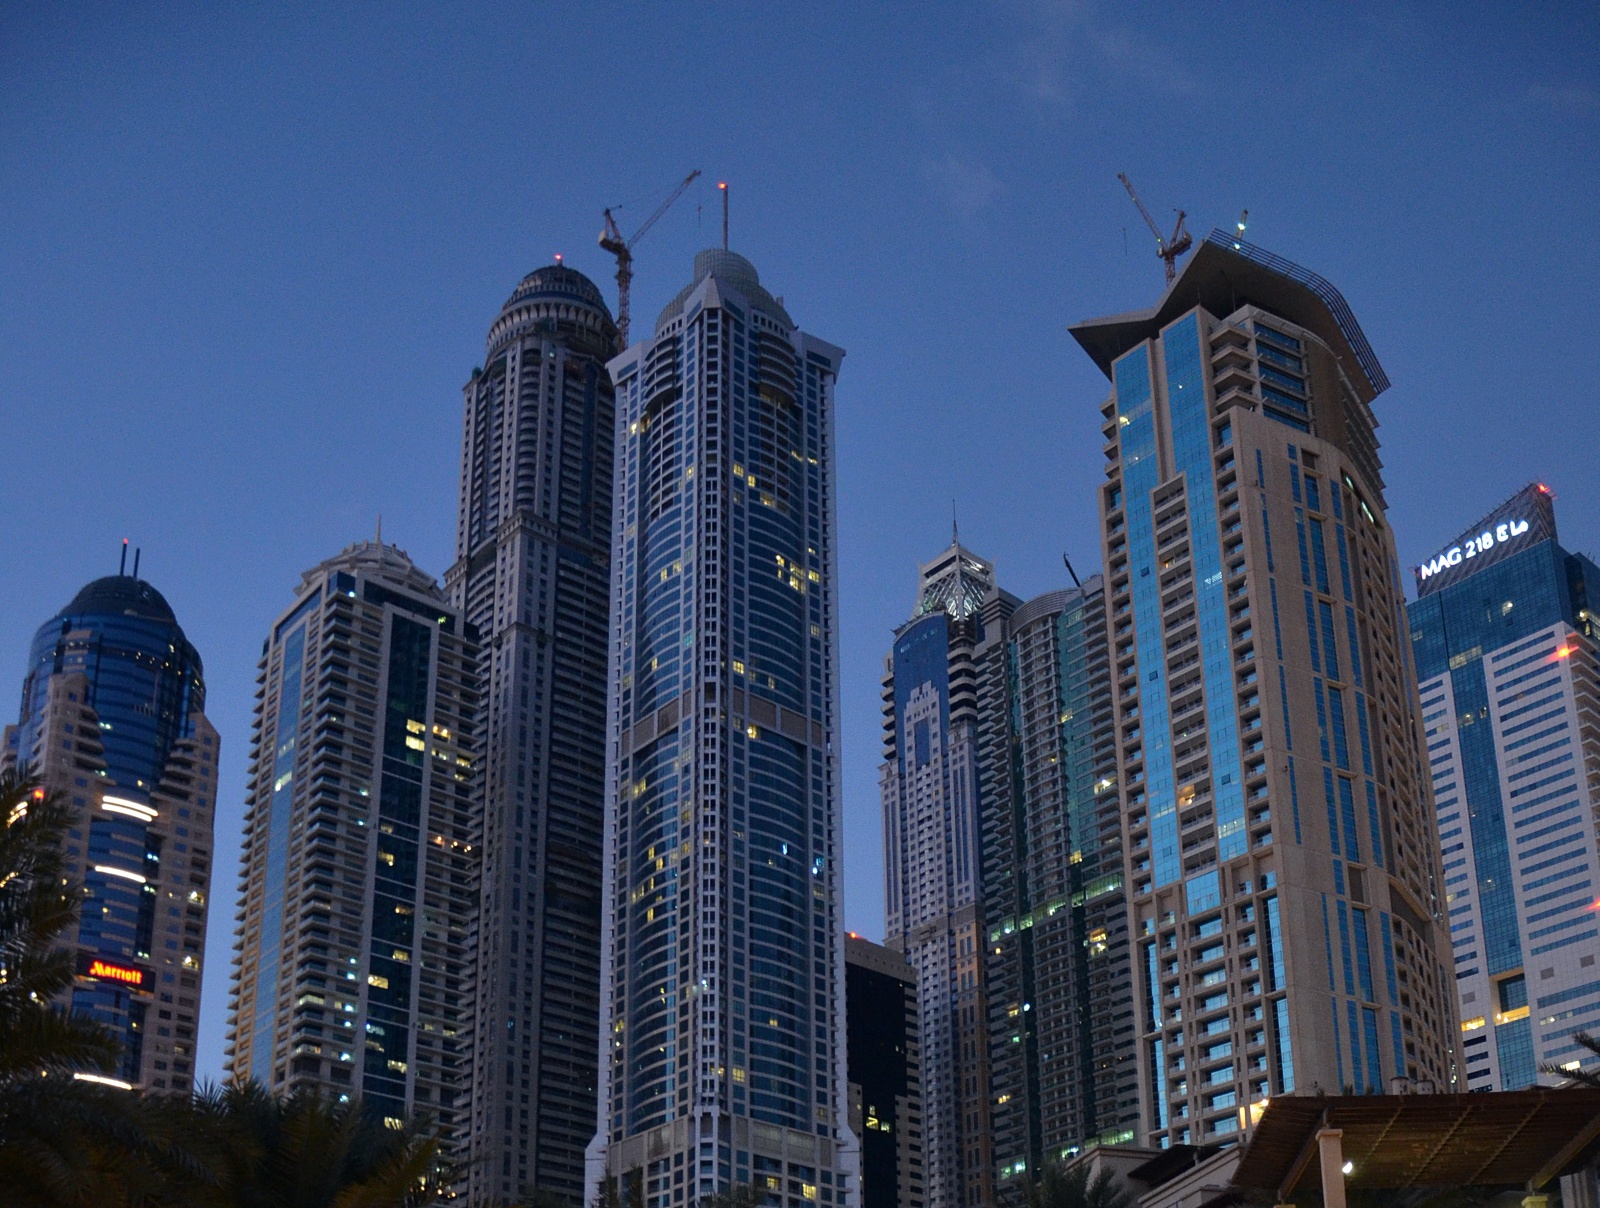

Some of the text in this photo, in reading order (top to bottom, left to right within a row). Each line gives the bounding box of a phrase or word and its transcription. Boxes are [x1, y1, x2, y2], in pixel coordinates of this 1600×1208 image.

[1421, 532, 1494, 580] MAG 218
[89, 960, 143, 985] Marriott
